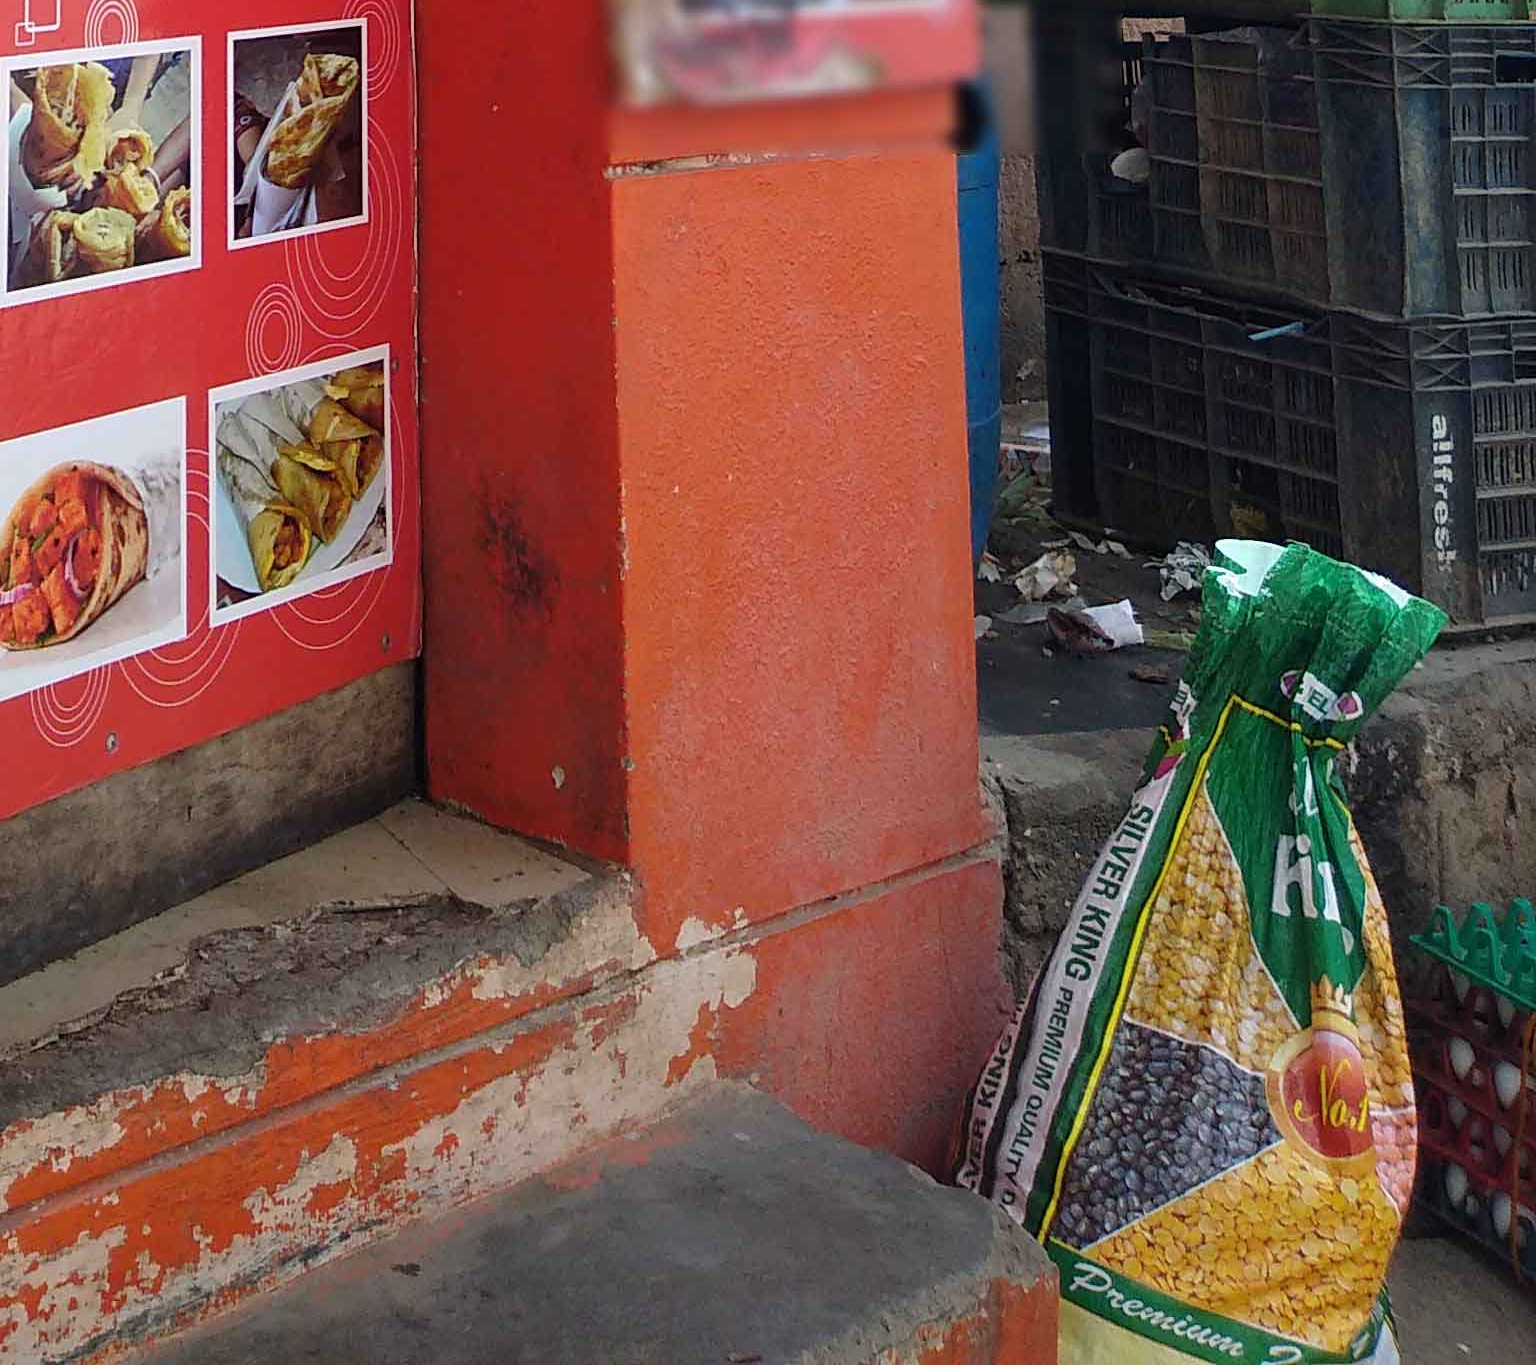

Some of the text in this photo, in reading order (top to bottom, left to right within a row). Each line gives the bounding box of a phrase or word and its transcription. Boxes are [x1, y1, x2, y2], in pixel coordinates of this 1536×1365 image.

[1092, 803, 1154, 903] SILVER
[1064, 904, 1112, 982] KING
[1031, 986, 1073, 1092] PREMIUM
[1005, 1093, 1043, 1190] QUALITY
[1068, 1261, 1245, 1358] Premium
